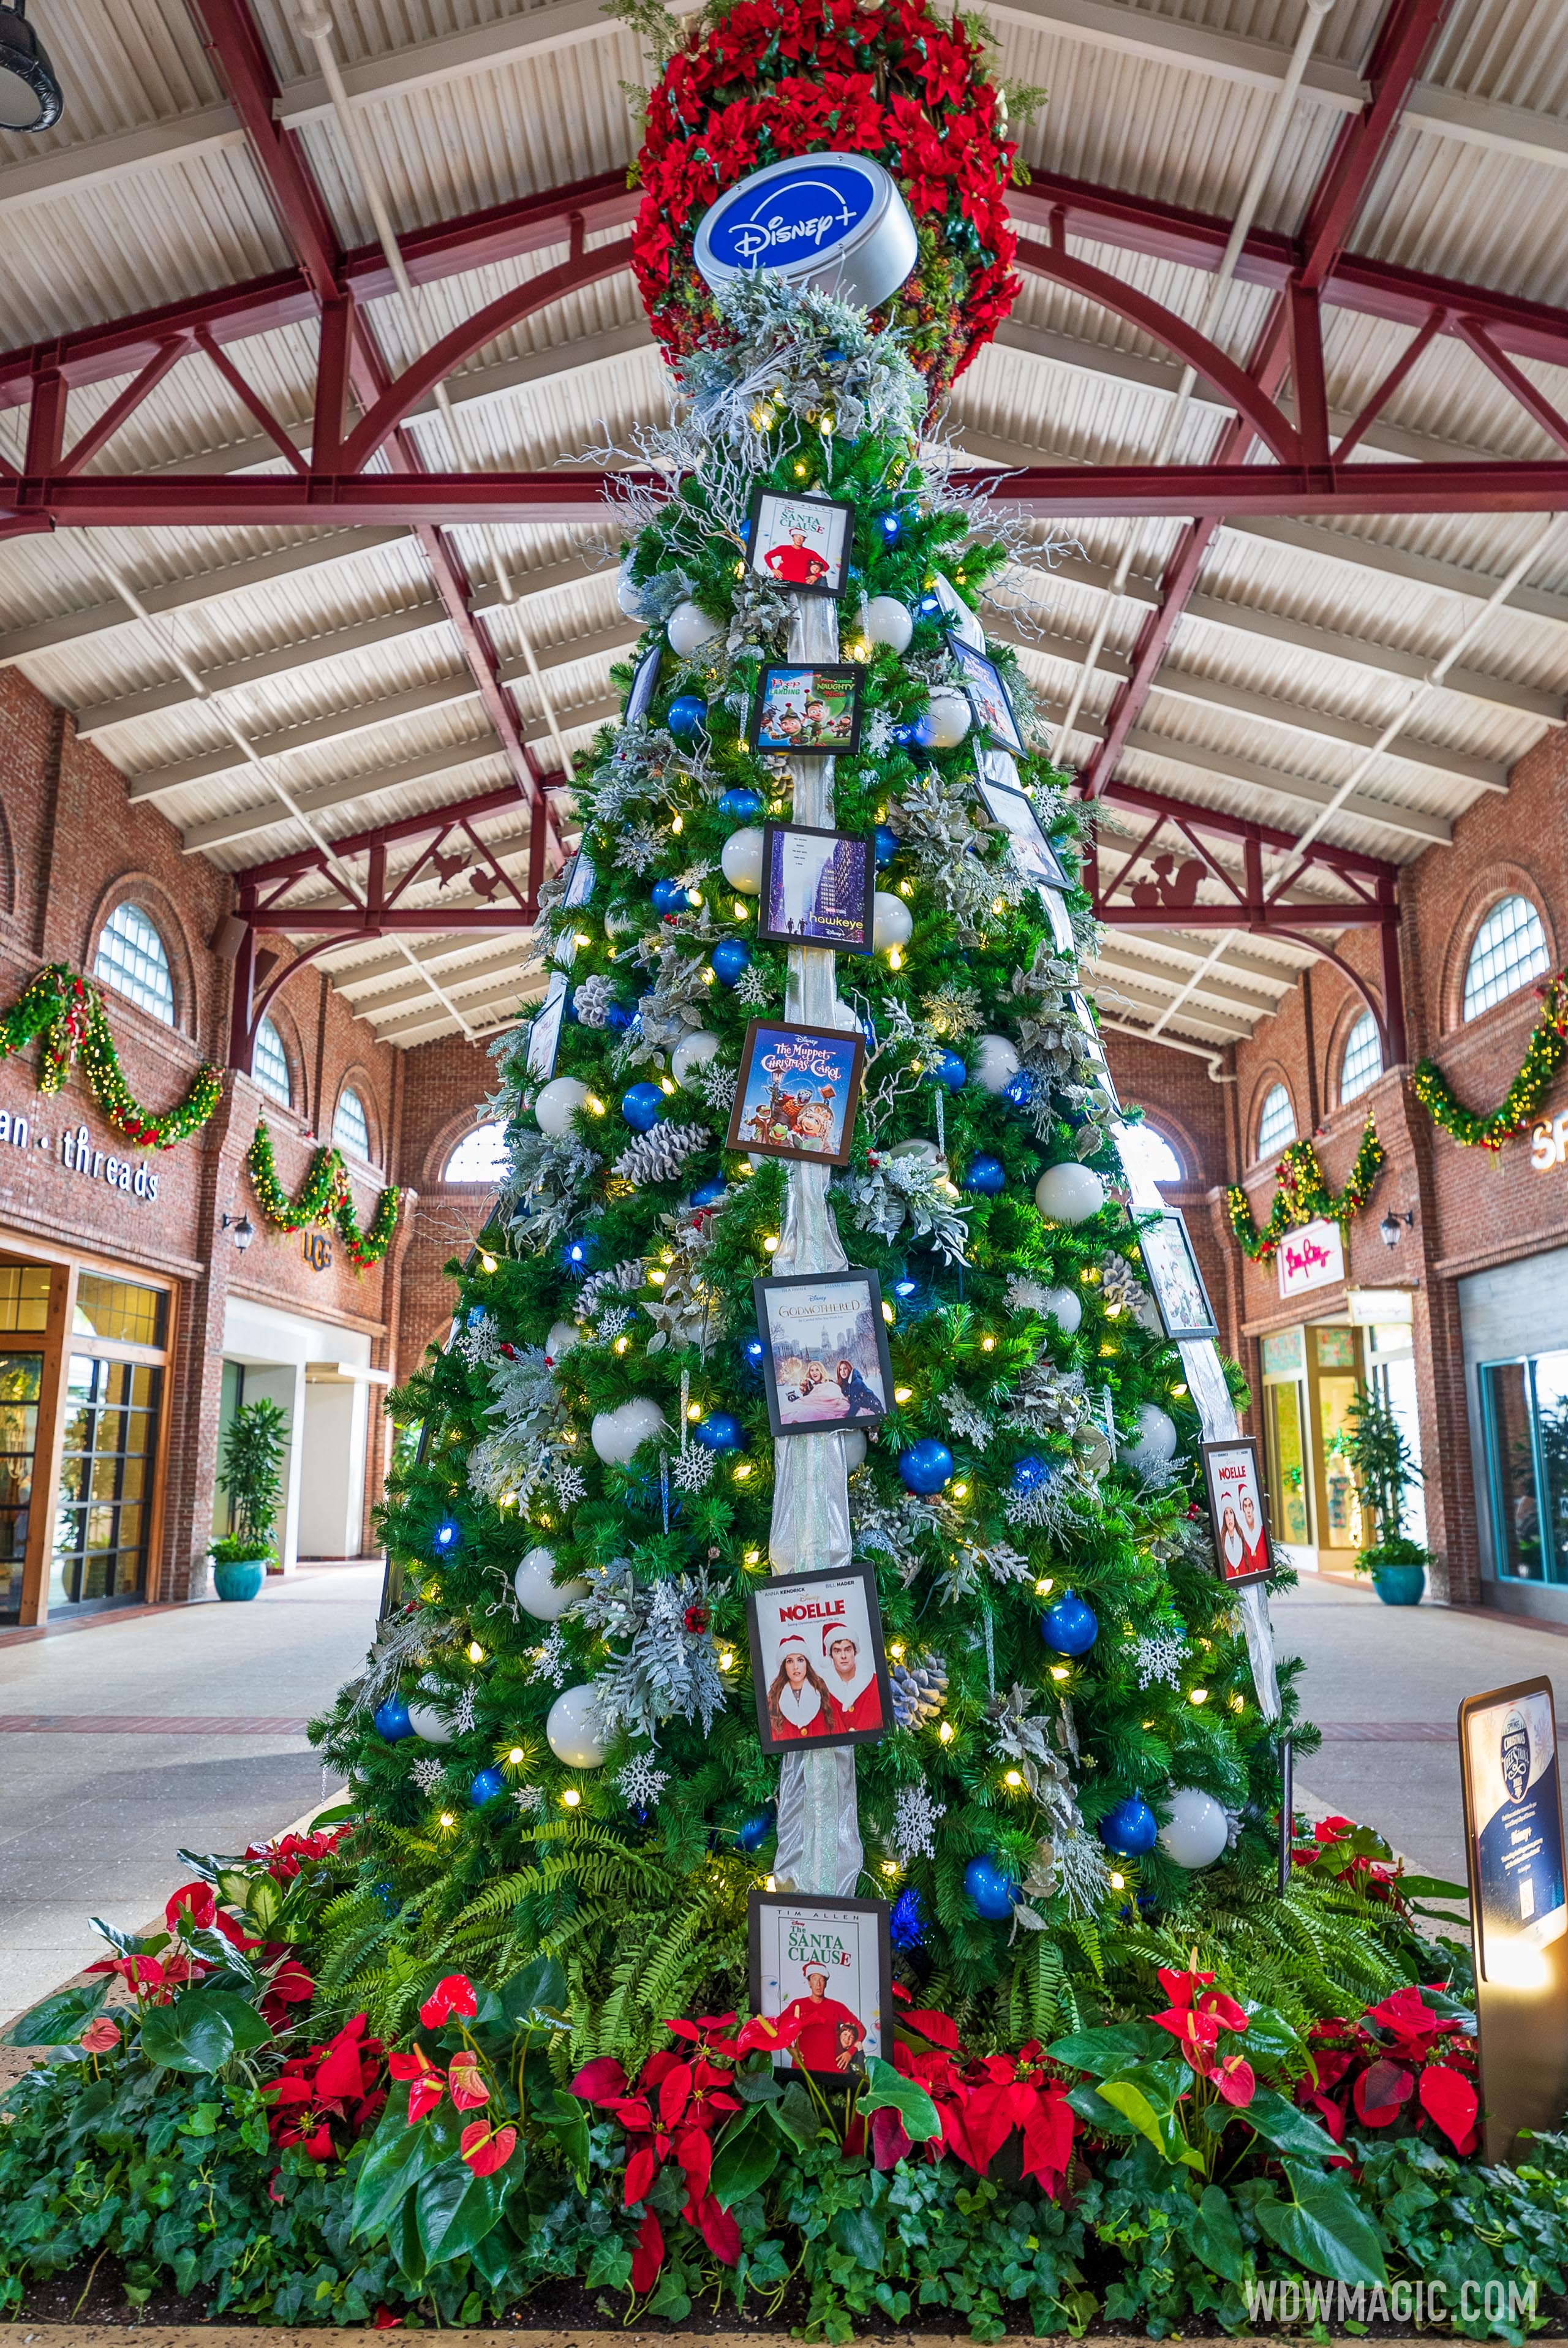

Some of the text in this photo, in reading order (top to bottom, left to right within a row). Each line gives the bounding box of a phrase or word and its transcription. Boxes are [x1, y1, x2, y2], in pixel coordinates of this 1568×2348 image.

[728, 205, 857, 257] Disney+
[780, 519, 825, 534] CLAUSE
[781, 511, 821, 525] SANTA
[772, 678, 801, 688] Prep
[809, 911, 864, 930] hawkeye
[794, 1034, 818, 1046] Disney
[774, 1043, 836, 1062] The Muppet
[64, 1125, 159, 1201] threads
[304, 1231, 332, 1271] UGG
[778, 1299, 860, 1318] GODMOTHERED
[1218, 1465, 1246, 1481] NOELLE
[779, 1599, 845, 1622] NOELLE
[789, 1932, 844, 1950] SANTA
[788, 1947, 851, 1967] CLAUSE
